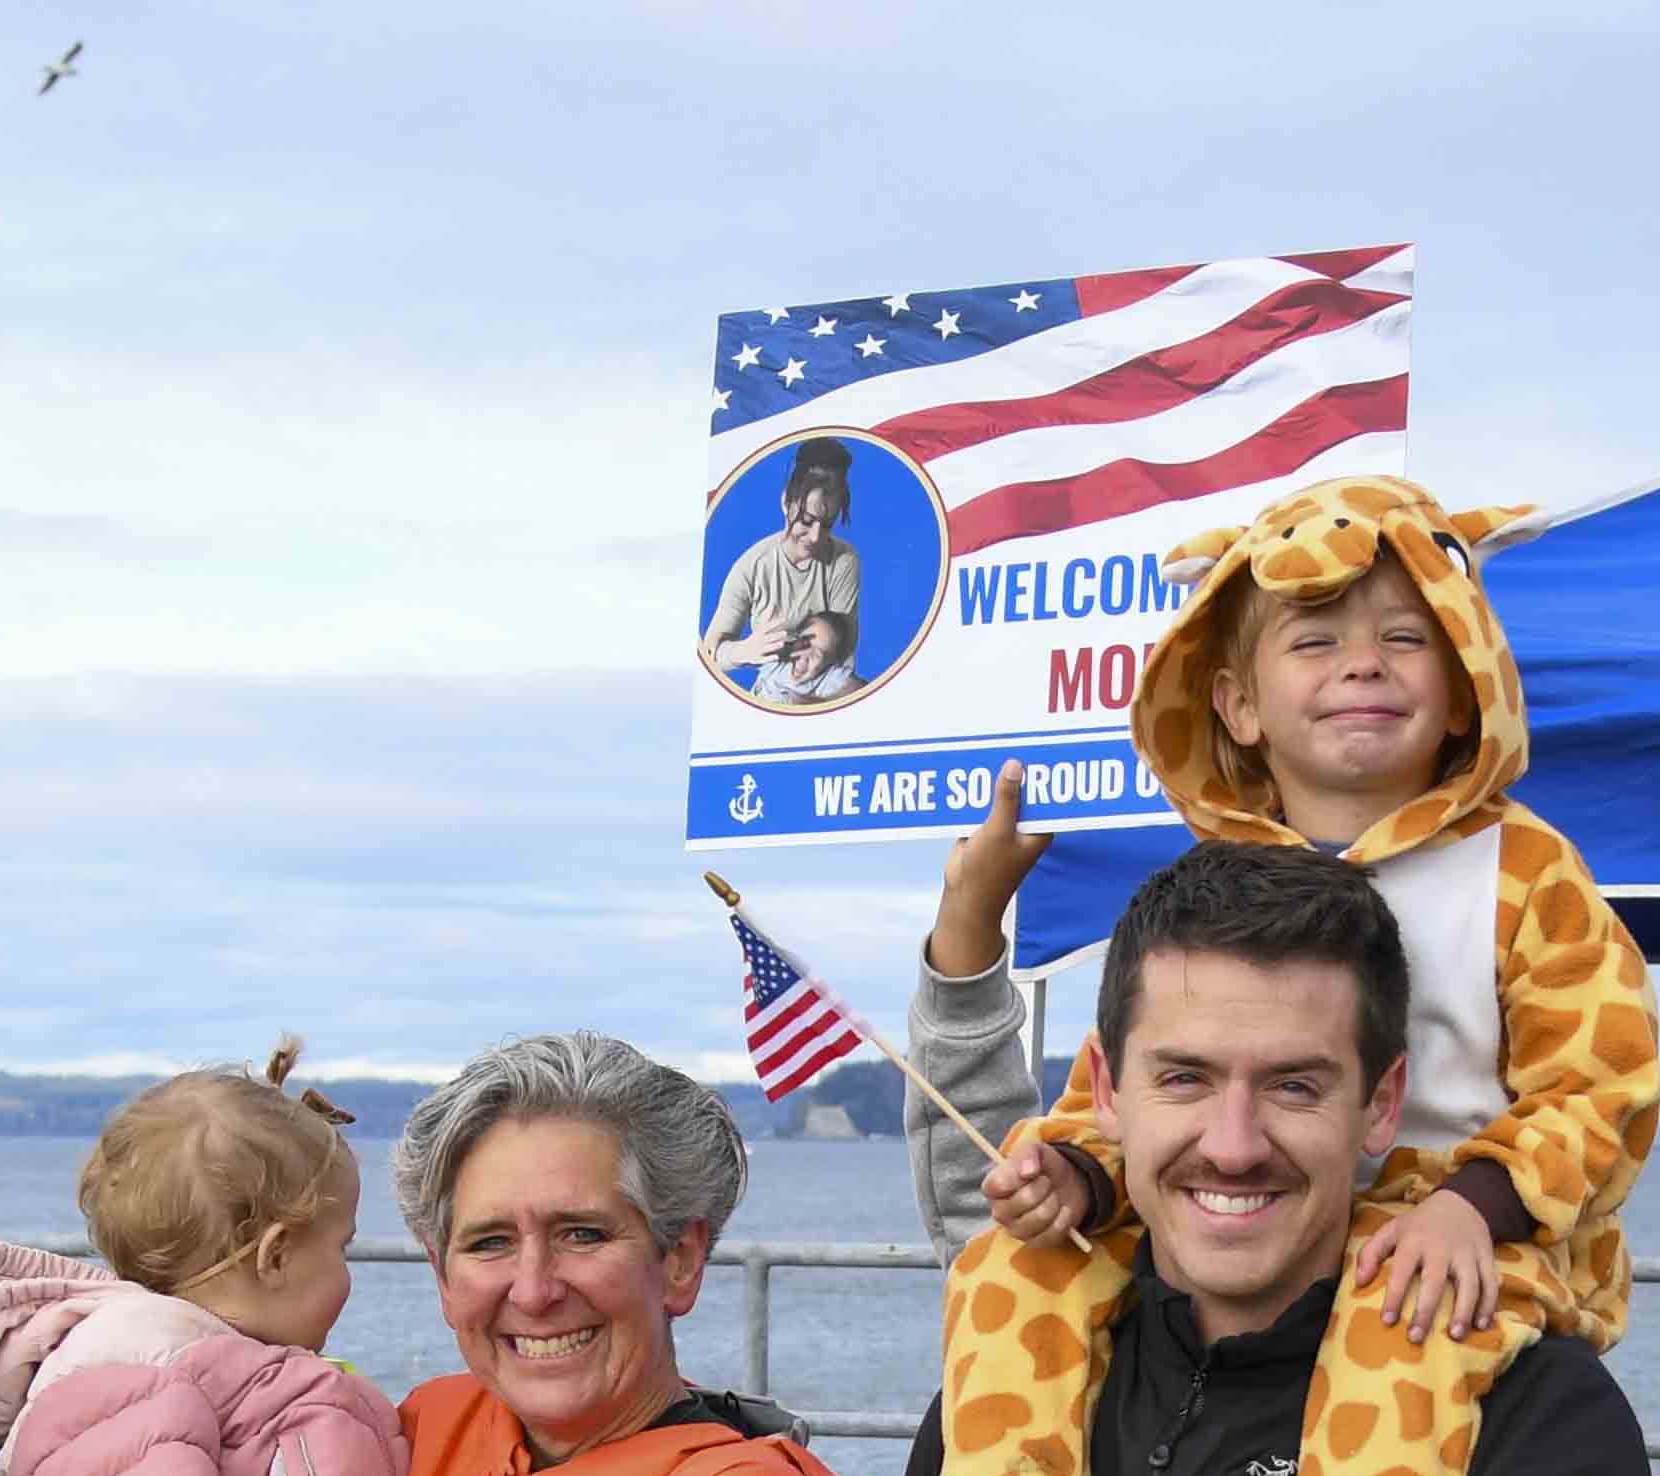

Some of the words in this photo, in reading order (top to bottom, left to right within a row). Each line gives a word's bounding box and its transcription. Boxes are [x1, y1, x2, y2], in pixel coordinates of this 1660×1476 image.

[959, 553, 1197, 626] WELCOM
[1048, 642, 1157, 713] MO
[813, 774, 861, 817] WE
[868, 769, 937, 815] ARE
[946, 766, 992, 808] SO
[1021, 758, 1125, 804] ROUD
